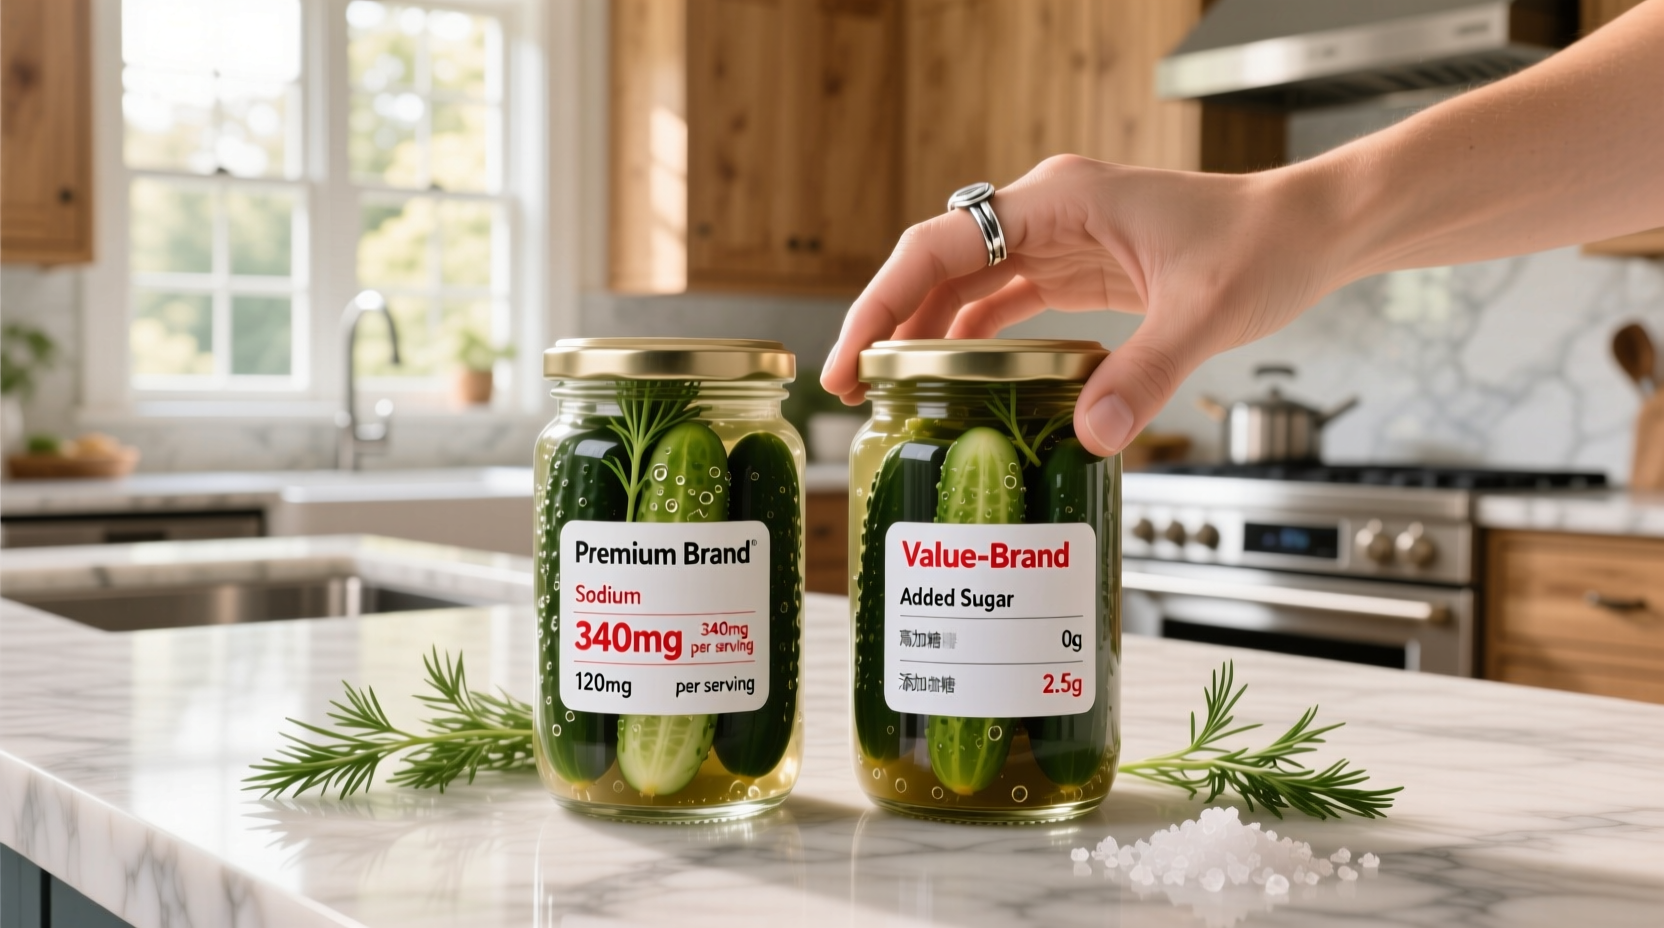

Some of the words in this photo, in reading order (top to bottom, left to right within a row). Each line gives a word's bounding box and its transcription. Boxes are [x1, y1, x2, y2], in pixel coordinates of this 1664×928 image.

[576, 541, 676, 565] Premium
[902, 540, 1069, 568] Value-Brand
[576, 584, 641, 604] Sodium
[900, 587, 955, 607] Added
[961, 588, 1014, 612] Sugar
[575, 620, 682, 661] 340mg
[701, 621, 748, 639] 340mg
[1062, 630, 1082, 652] 0g
[691, 643, 711, 658] per
[576, 672, 631, 698] 120mg
[676, 682, 701, 698] per
[704, 676, 754, 695] serving
[1043, 673, 1082, 697] 2.5g
